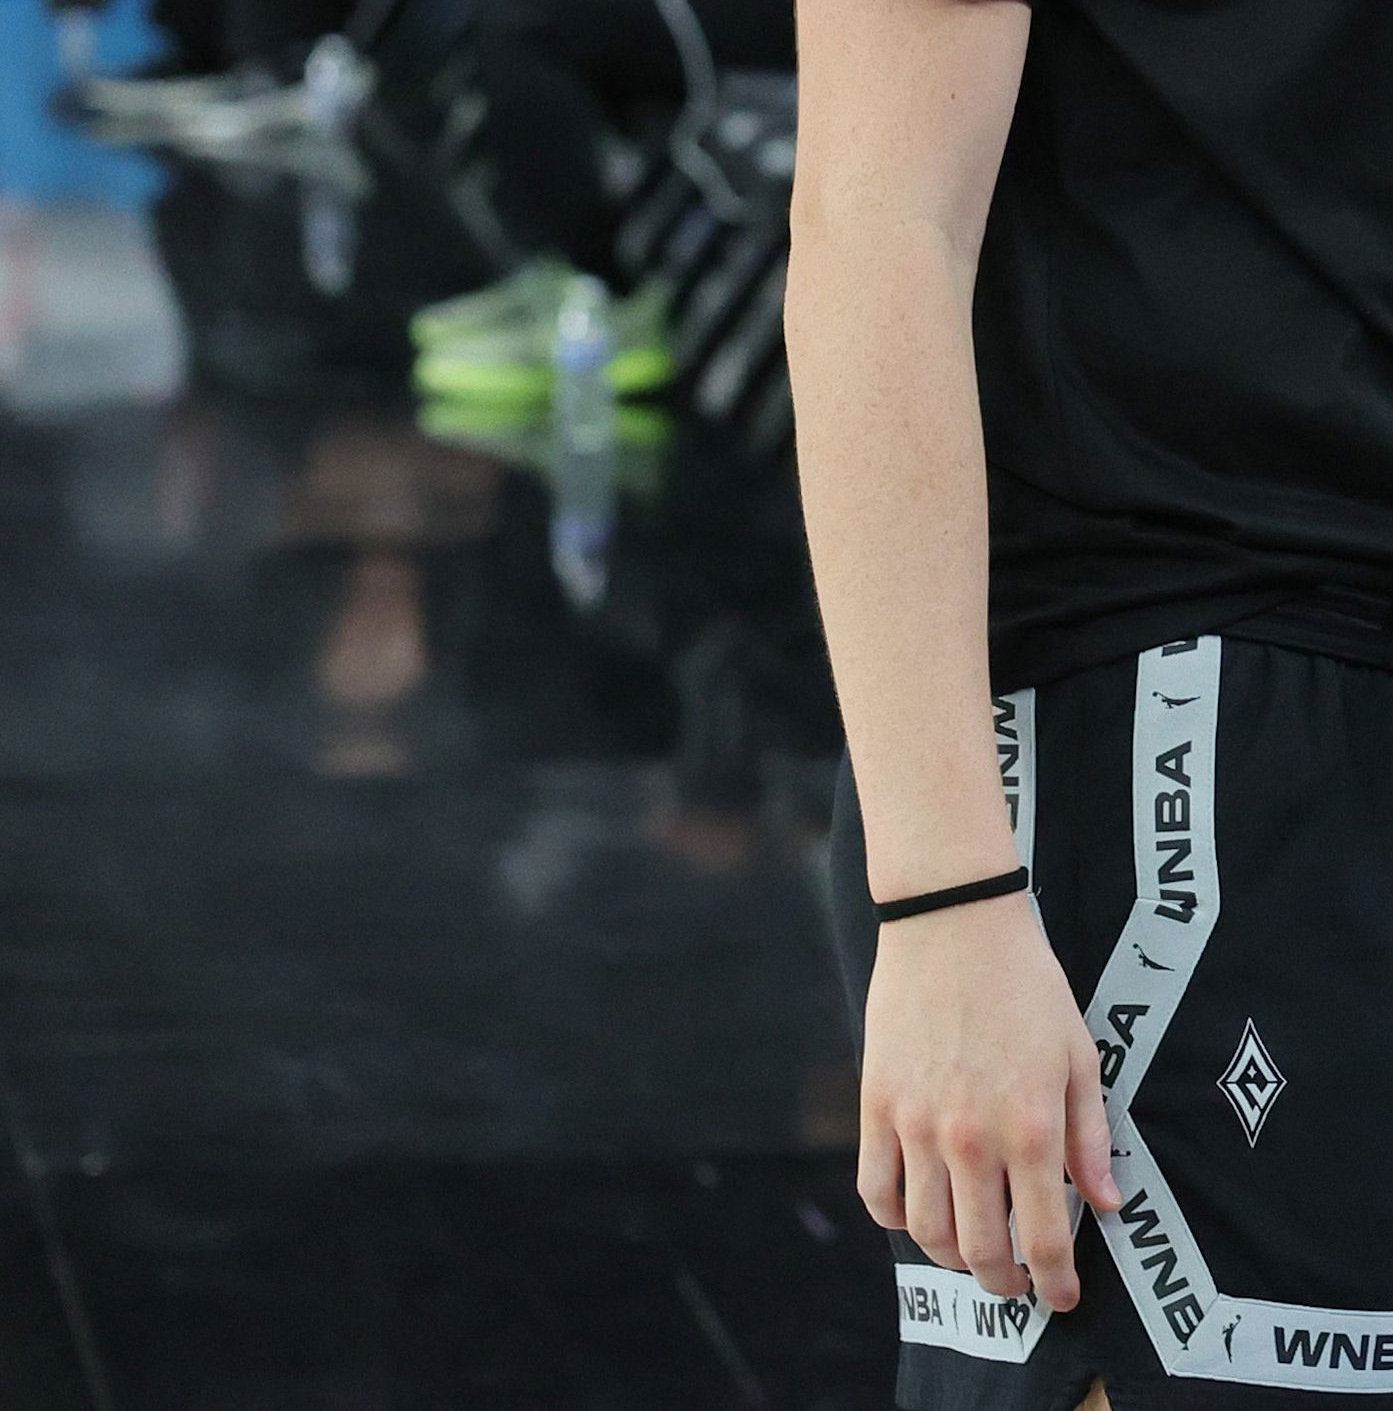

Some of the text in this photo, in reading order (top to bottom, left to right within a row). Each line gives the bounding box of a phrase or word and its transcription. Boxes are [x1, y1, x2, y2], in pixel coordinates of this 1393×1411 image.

[1154, 740, 1198, 924] WNBA
[901, 1285, 944, 1327] NBA
[1118, 1187, 1206, 1352] WNB
